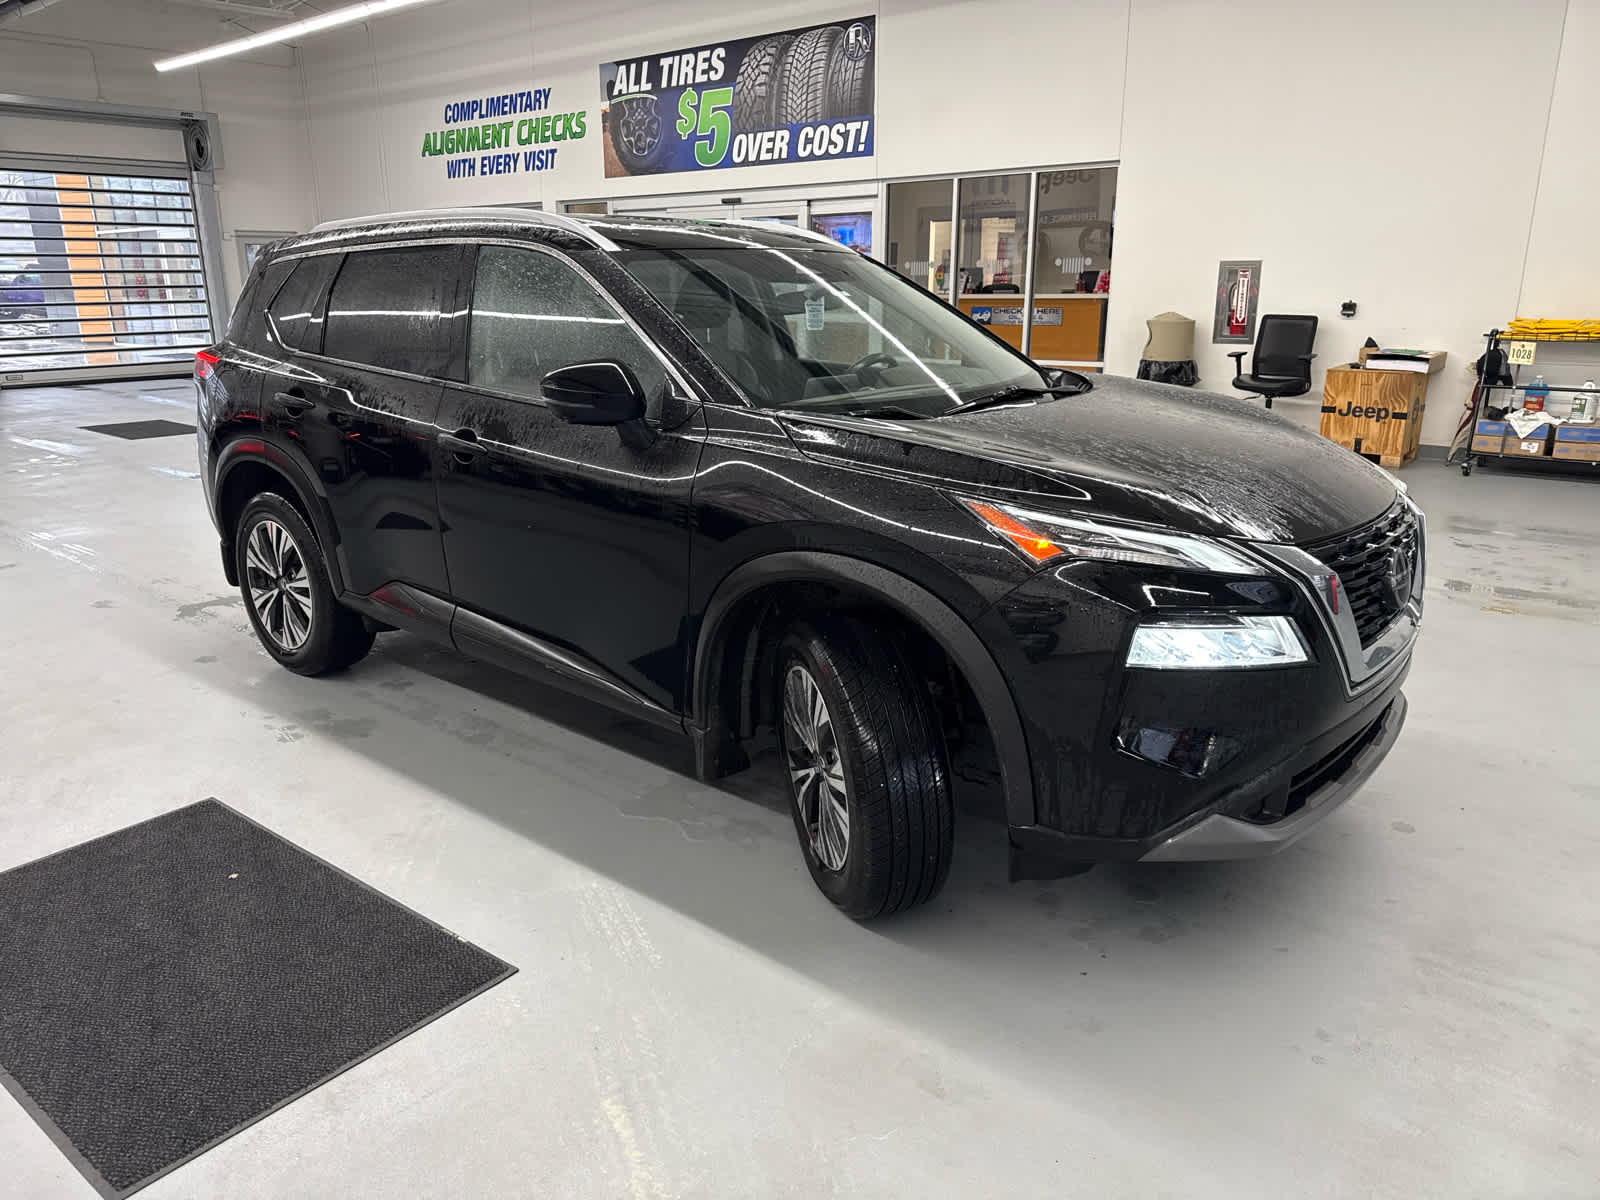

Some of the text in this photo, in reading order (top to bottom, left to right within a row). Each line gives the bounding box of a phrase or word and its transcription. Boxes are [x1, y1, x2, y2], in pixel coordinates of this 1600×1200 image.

[612, 47, 726, 96] ALL TIRES
[444, 87, 552, 124] COMPLIMENTARY
[421, 111, 587, 157] ALIGNMENT CHECKS
[676, 87, 734, 167] $5
[732, 120, 869, 163] OVER COST!
[447, 148, 558, 179] WITH EVERY VISIT
[1511, 348, 1533, 360] 1028
[1337, 400, 1390, 423] Jeep
